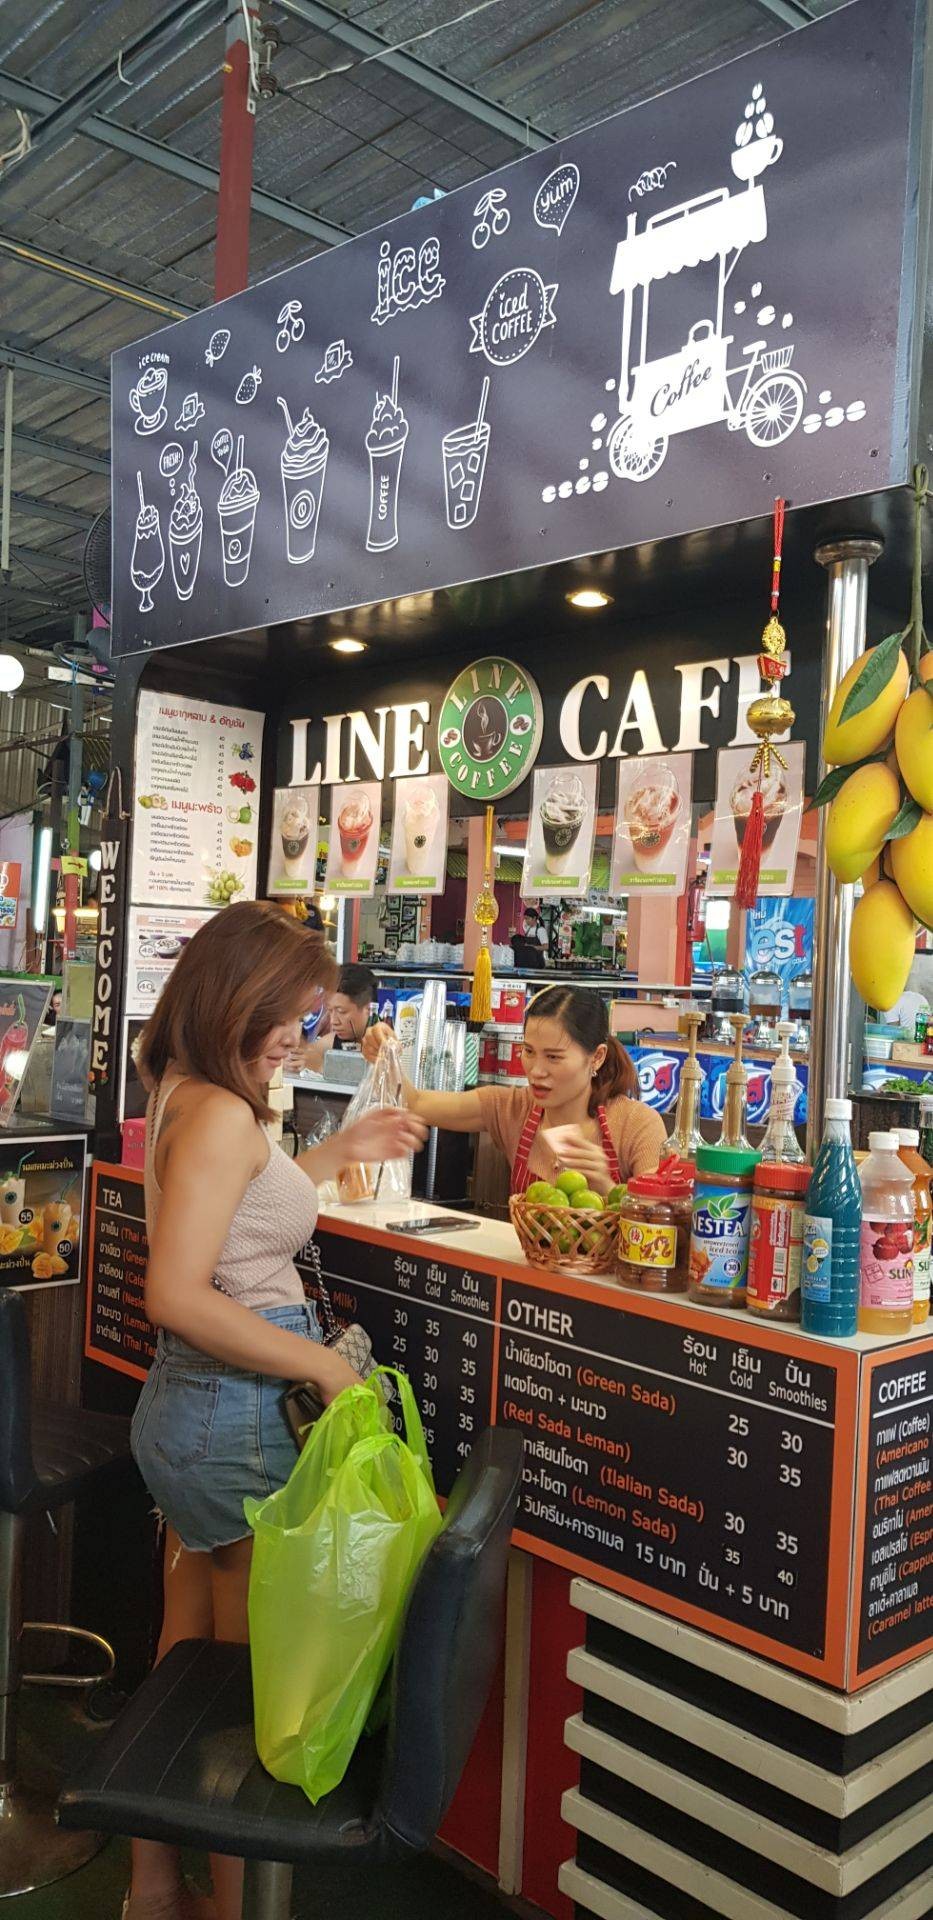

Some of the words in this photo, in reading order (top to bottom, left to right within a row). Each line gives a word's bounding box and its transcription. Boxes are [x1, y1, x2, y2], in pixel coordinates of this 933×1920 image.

[540, 170, 576, 214] yum
[377, 237, 442, 315] ice
[499, 282, 529, 318] iced
[491, 311, 533, 345] COFFEE
[138, 354, 150, 369] ice
[150, 352, 170, 364] cream
[650, 358, 713, 418] Coffee
[163, 451, 181, 470] FRESH!
[378, 474, 389, 520] COFFEE
[450, 664, 525, 712] LINE
[288, 701, 430, 787] LINE
[559, 650, 792, 761] CAFE
[449, 741, 523, 789] COFFEE
[91, 840, 121, 1072] WELCOME
[750, 924, 807, 965] est
[20, 1211, 32, 1222] 55
[102, 1188, 122, 1209] TEA
[59, 1243, 70, 1253] 50
[394, 1256, 418, 1276] ร้อน
[426, 1263, 447, 1284] เย็น
[461, 1271, 479, 1293] ปั่น
[398, 1274, 411, 1289] Hot
[425, 1282, 441, 1298] Cold
[450, 1289, 489, 1312] Smoothies
[394, 1309, 408, 1326] 30
[425, 1319, 440, 1337] 35
[462, 1331, 478, 1348] 40
[507, 1299, 574, 1338] OTHER
[392, 1335, 407, 1352] 25
[424, 1346, 439, 1363] 30
[461, 1358, 476, 1376] 35
[683, 1335, 717, 1361] ร้อน
[732, 1348, 762, 1374] เย็น
[785, 1359, 811, 1388] ปั่น
[423, 1372, 437, 1390] 30
[460, 1385, 475, 1404] 35
[689, 1358, 708, 1377] Hot
[729, 1370, 753, 1390] Cold
[768, 1381, 827, 1412] Smoothies
[878, 1370, 927, 1404] COFFEE
[422, 1400, 436, 1417] 30
[458, 1413, 473, 1431] 35
[576, 1366, 626, 1397] (Green
[631, 1384, 676, 1416] Sada)
[728, 1414, 749, 1436] 25
[781, 1430, 803, 1453] 30
[876, 1423, 897, 1446] กาแฟ
[898, 1412, 930, 1442] (Coffee)
[503, 1400, 533, 1425] (Red
[537, 1414, 571, 1438] Sada
[576, 1426, 631, 1464] Leman)
[558, 1394, 566, 1406] +
[571, 1396, 607, 1420] มะนาว
[727, 1446, 748, 1469] 30
[779, 1464, 801, 1488] 35
[876, 1437, 929, 1470] (Americano
[874, 1490, 899, 1516] (Thai
[902, 1480, 932, 1501] Coffee
[571, 1485, 626, 1522] (Lemon
[632, 1508, 676, 1545] Sada)
[724, 1548, 741, 1565] 35
[777, 1569, 794, 1586] 40
[658, 1487, 705, 1523] Sada)
[724, 1512, 745, 1535] 30
[776, 1531, 798, 1556] 35
[635, 1542, 654, 1565] 15
[659, 1553, 686, 1578] บาท
[699, 1561, 719, 1592] ปั่น
[725, 1582, 735, 1597] +
[742, 1585, 752, 1605] 5
[759, 1593, 790, 1621] บาท
[867, 1603, 912, 1640] (Caramel
